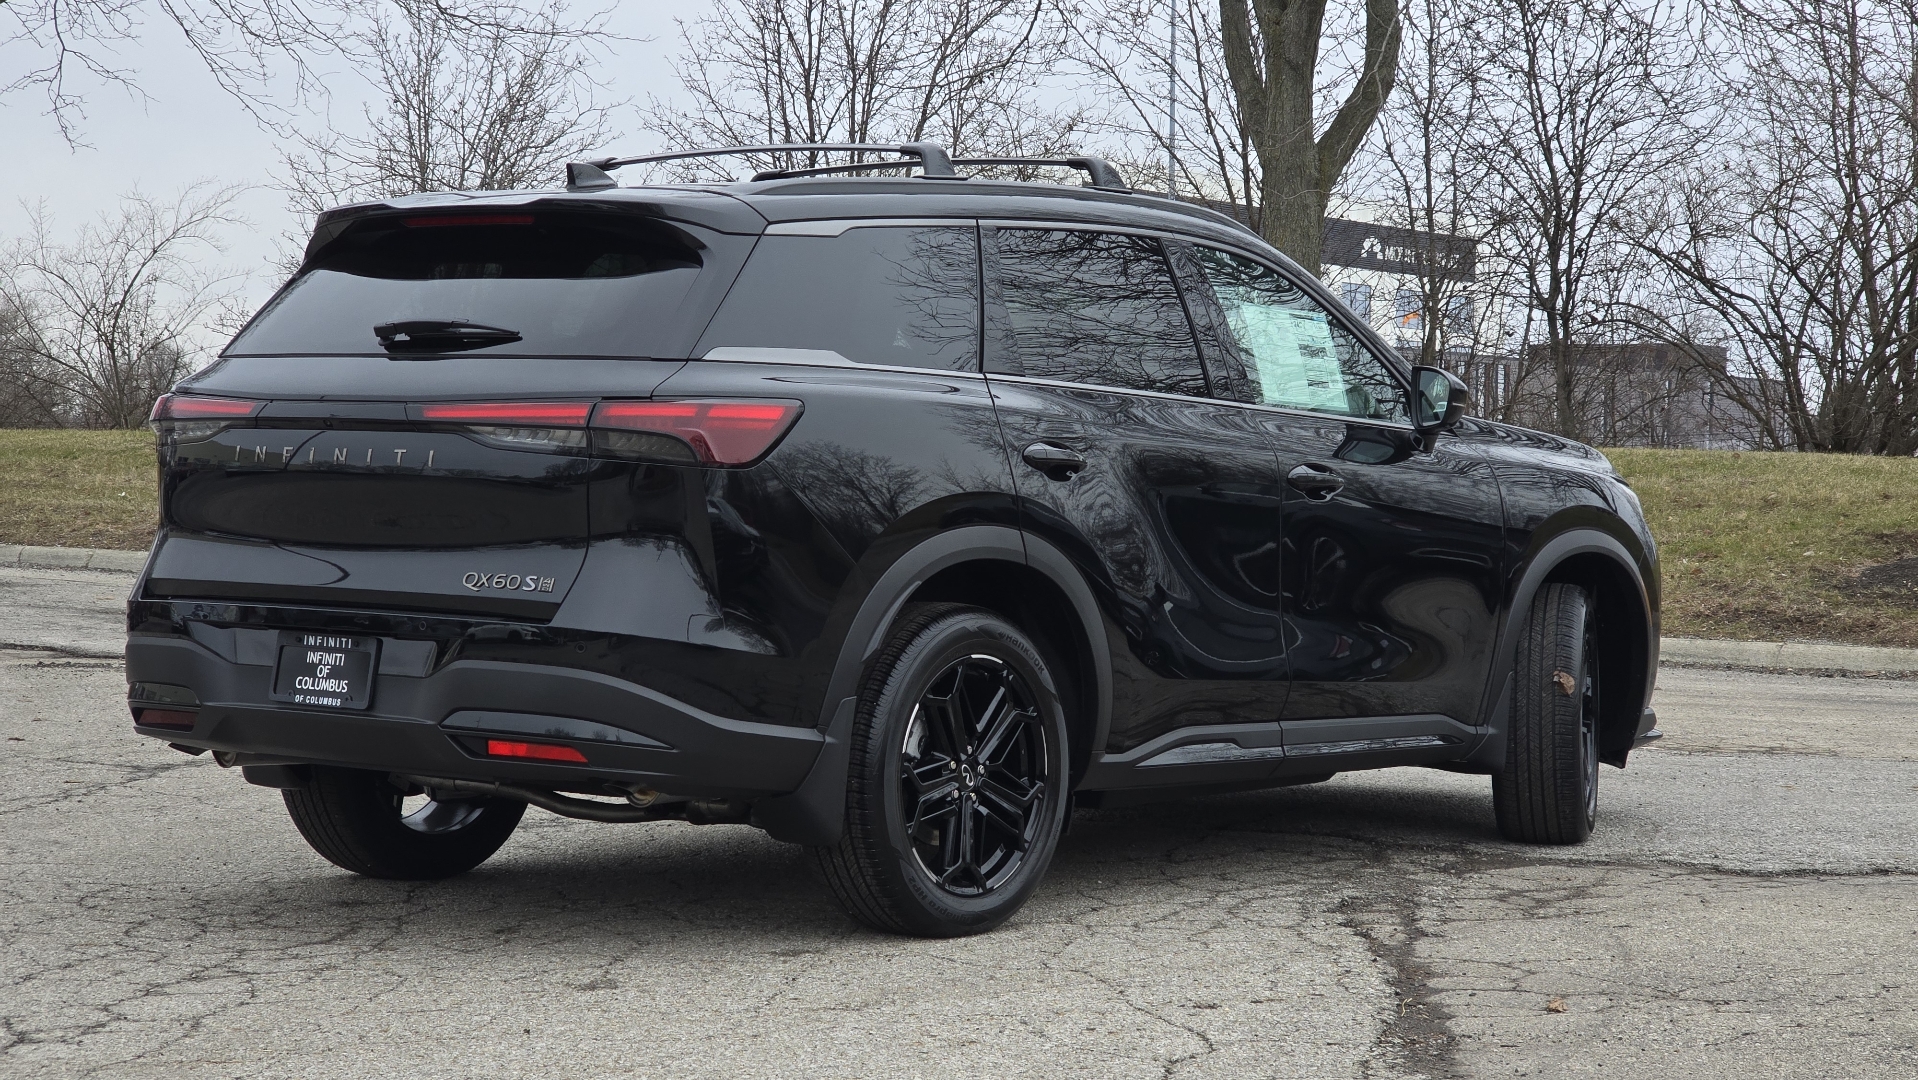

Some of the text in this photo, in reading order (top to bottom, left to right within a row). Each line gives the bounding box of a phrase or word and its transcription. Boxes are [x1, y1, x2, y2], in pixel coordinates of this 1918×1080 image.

[234, 445, 435, 468] INFINITI
[462, 571, 521, 591] QX60
[304, 635, 352, 649] INFINITI
[306, 651, 345, 666] INFINITI
[316, 665, 331, 677] OF
[295, 676, 348, 693] COLUMBUS
[305, 695, 341, 706] COLUMBUS
